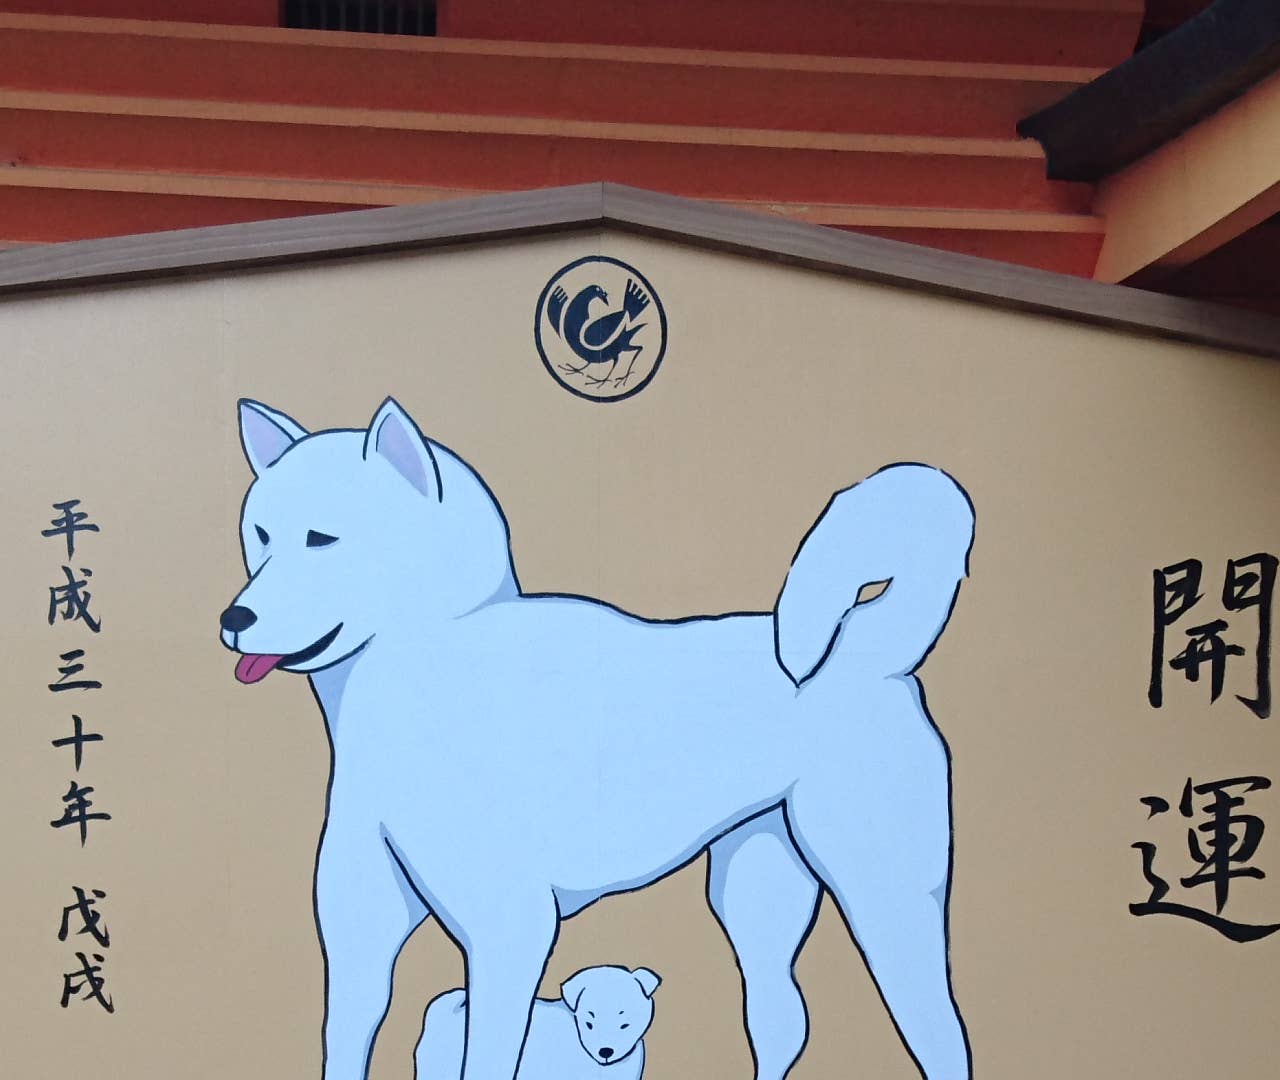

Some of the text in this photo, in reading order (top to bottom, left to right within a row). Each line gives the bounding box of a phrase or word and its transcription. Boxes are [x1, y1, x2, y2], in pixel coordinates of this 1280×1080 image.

[41, 498, 112, 846] 平成三十年
